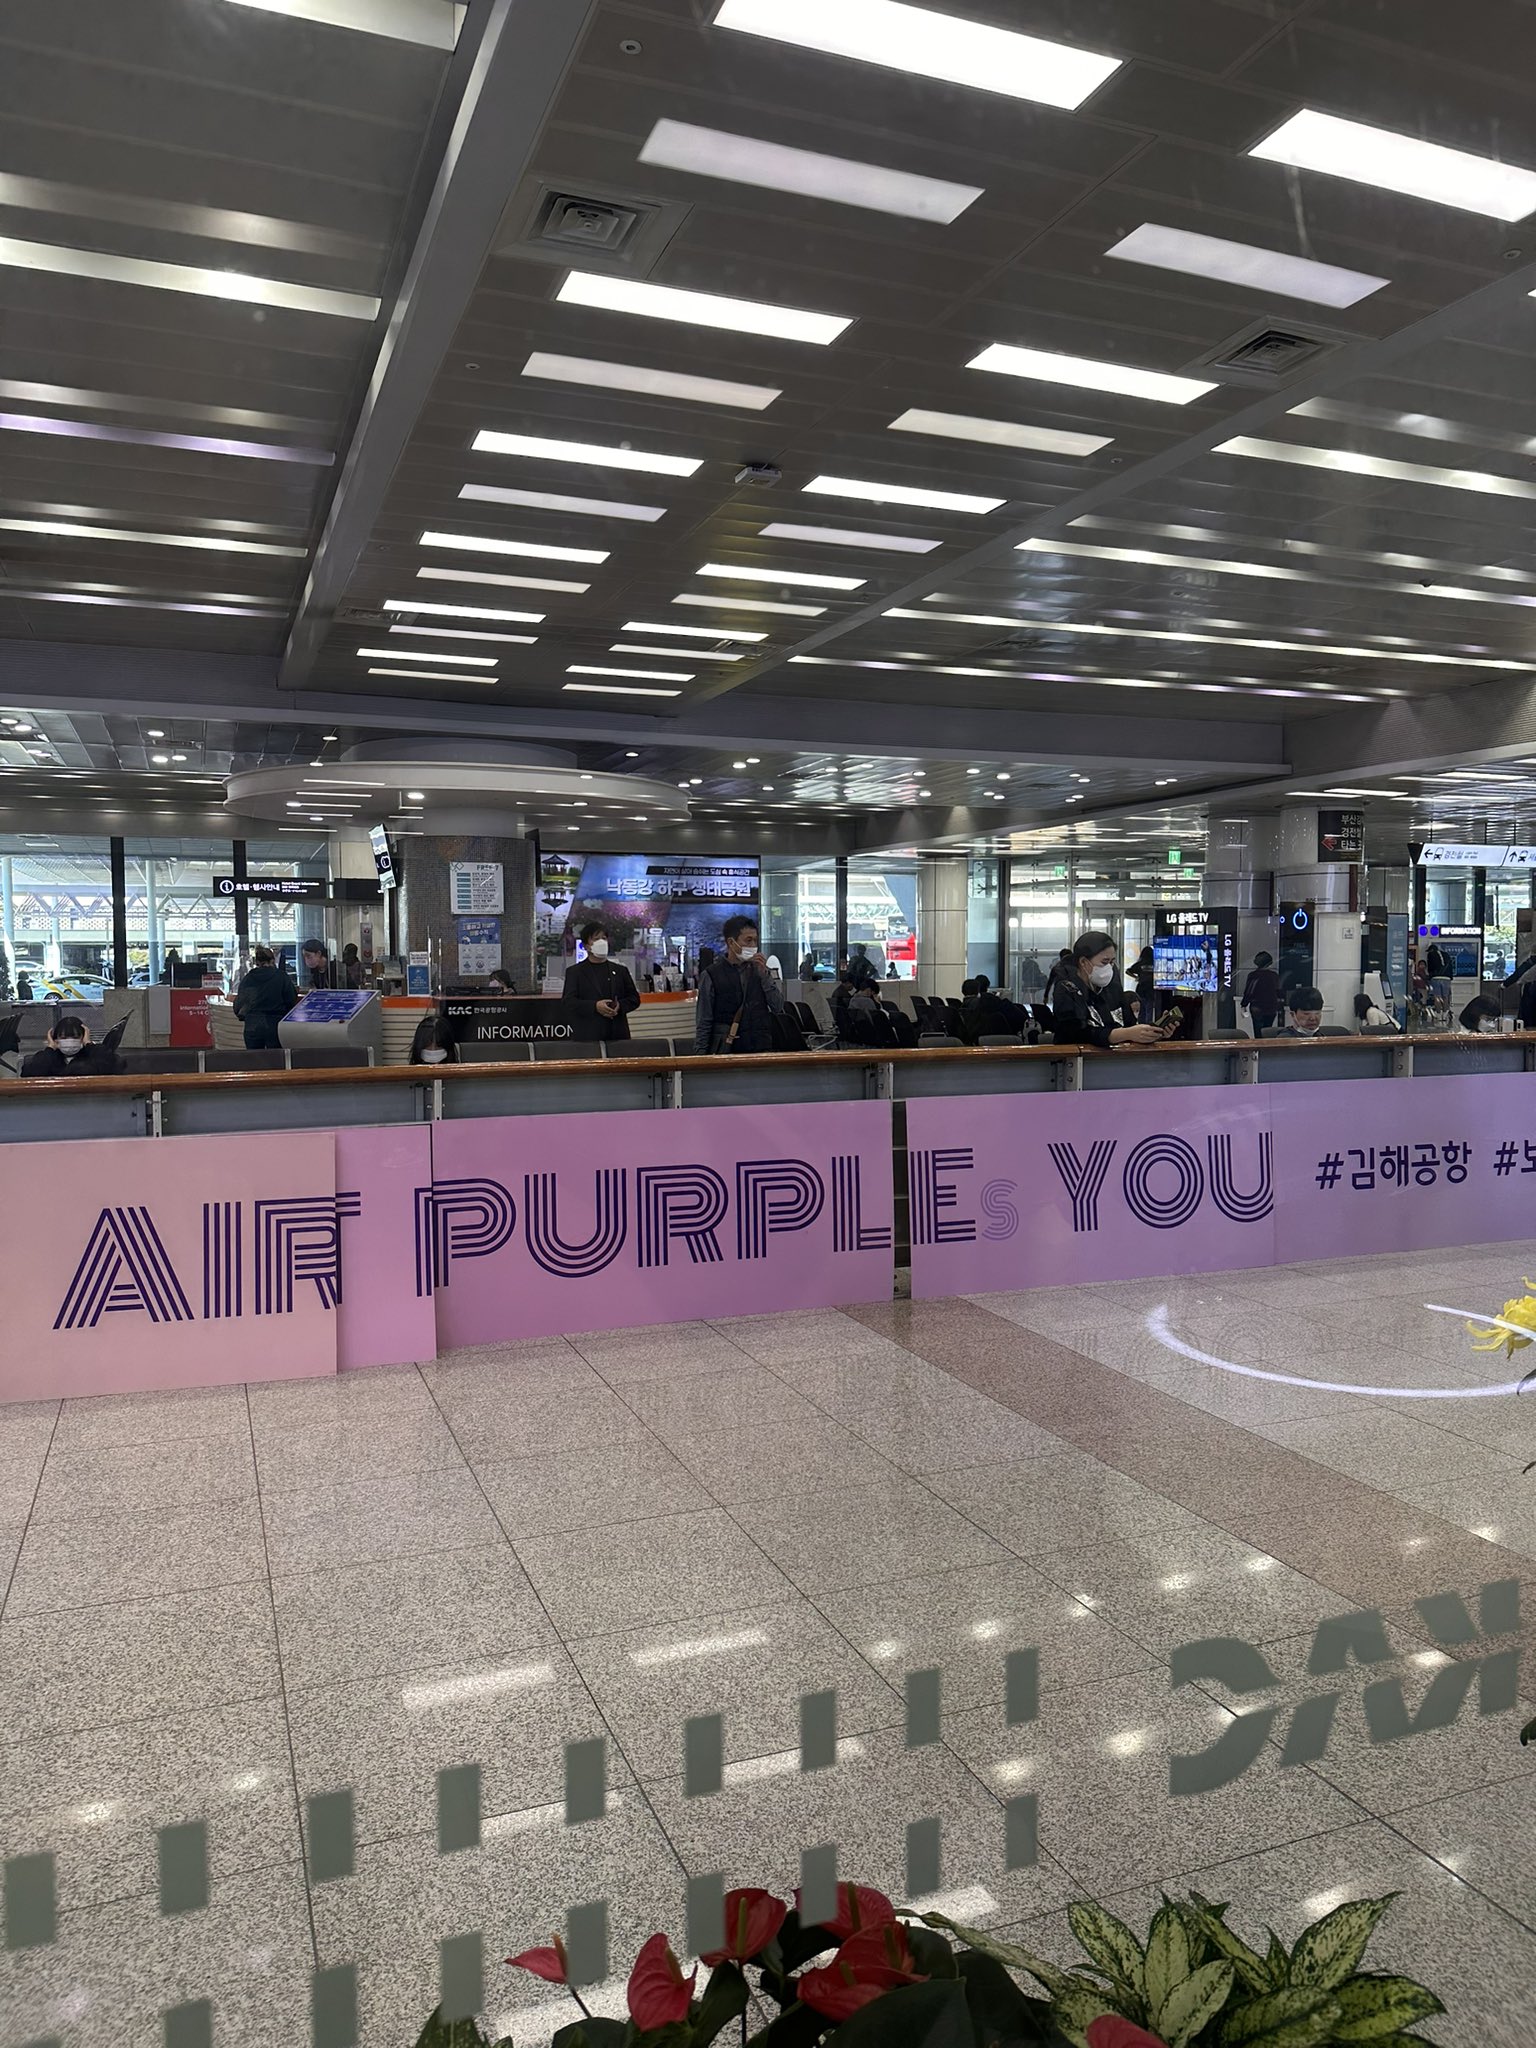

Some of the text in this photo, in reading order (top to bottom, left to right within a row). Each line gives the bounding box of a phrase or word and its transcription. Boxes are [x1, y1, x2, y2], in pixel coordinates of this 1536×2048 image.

[606, 878, 751, 897] 낙동강 하구 생태공원
[1166, 913, 1177, 923] LG
[1224, 934, 1231, 946] LG
[448, 1006, 472, 1015] KAC
[477, 1024, 574, 1039] INFORMATION
[1047, 1131, 1274, 1232] YOU
[1315, 1140, 1473, 1190] #김해공항
